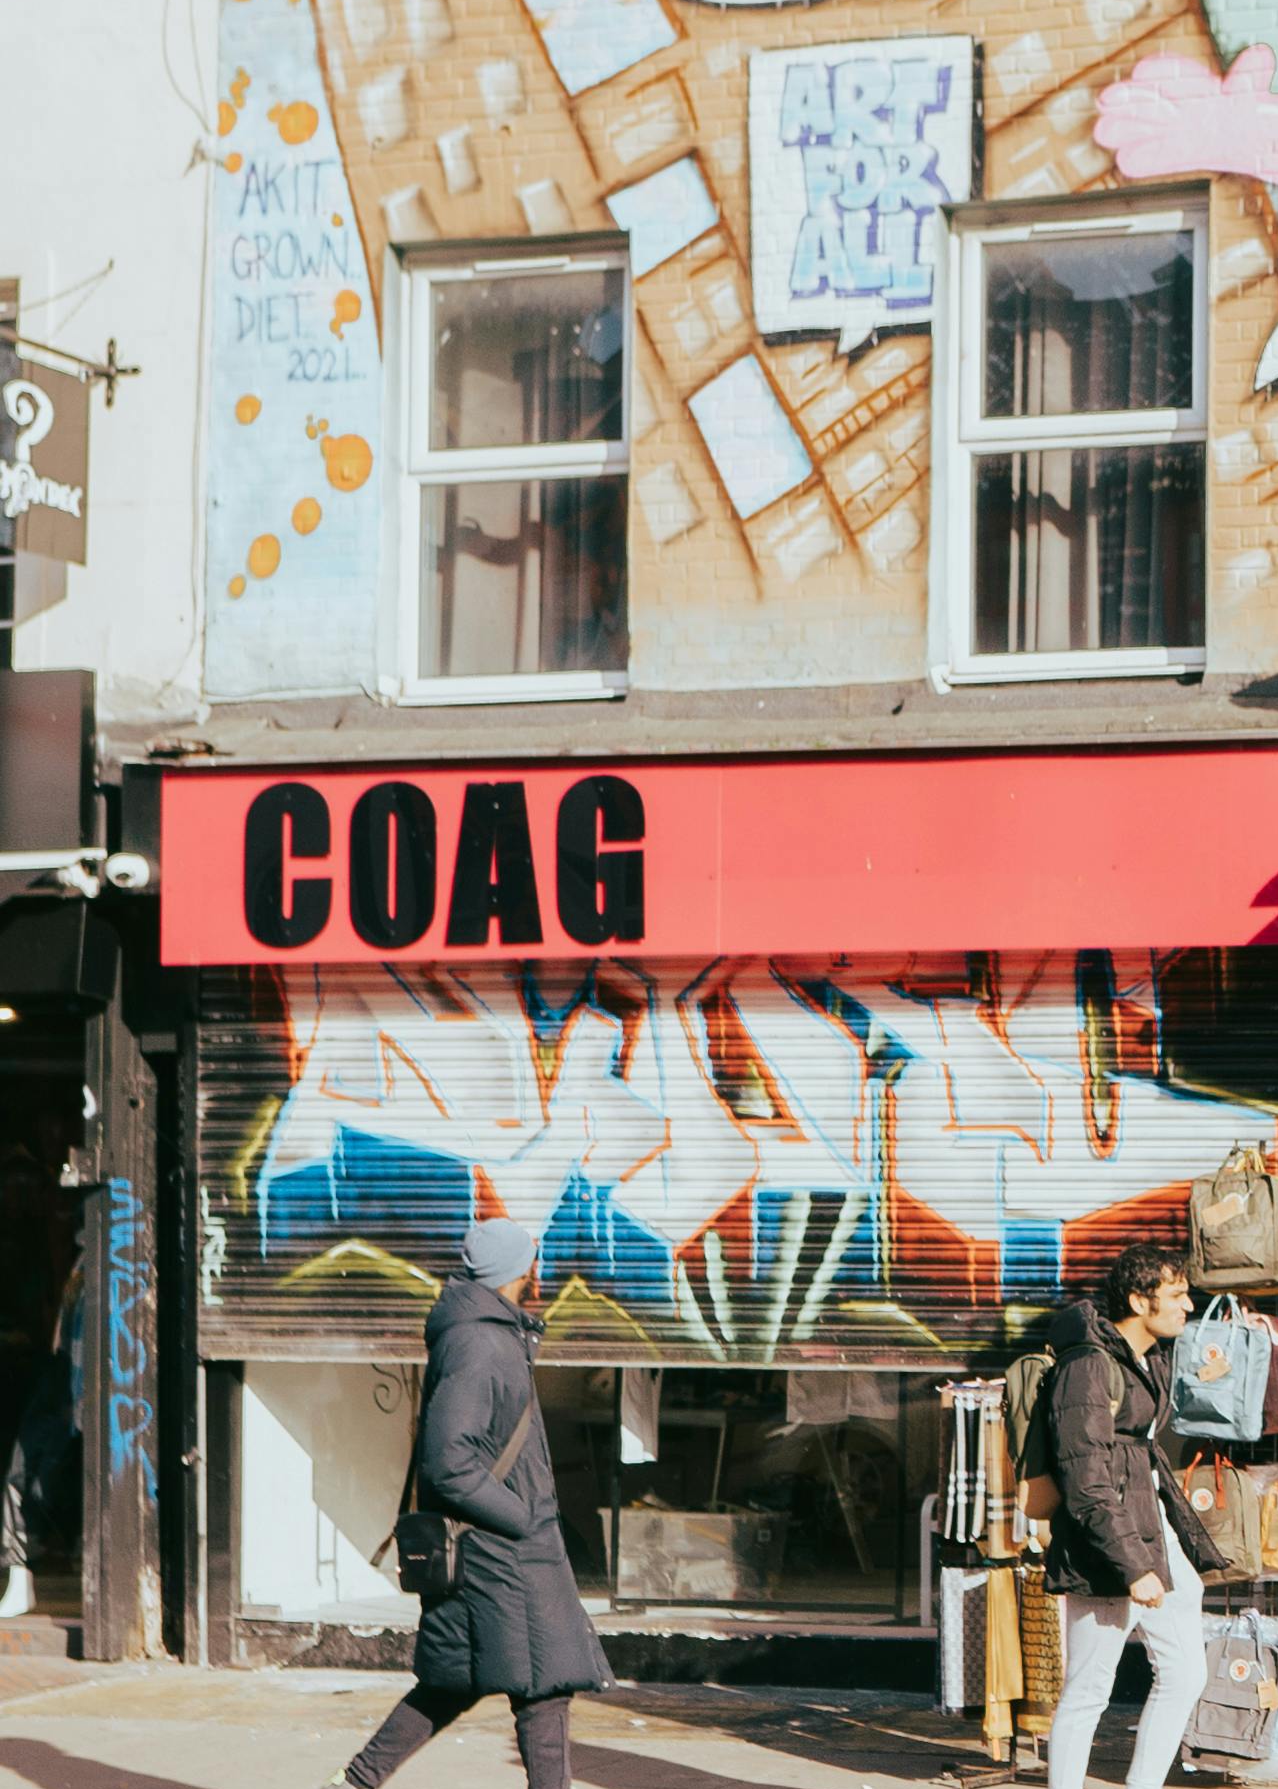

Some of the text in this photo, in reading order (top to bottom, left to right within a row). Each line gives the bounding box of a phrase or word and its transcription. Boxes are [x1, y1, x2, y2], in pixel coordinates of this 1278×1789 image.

[780, 58, 953, 148] ART
[800, 146, 955, 212] FOR
[789, 208, 934, 310] ALL
[243, 775, 646, 950] COAG
